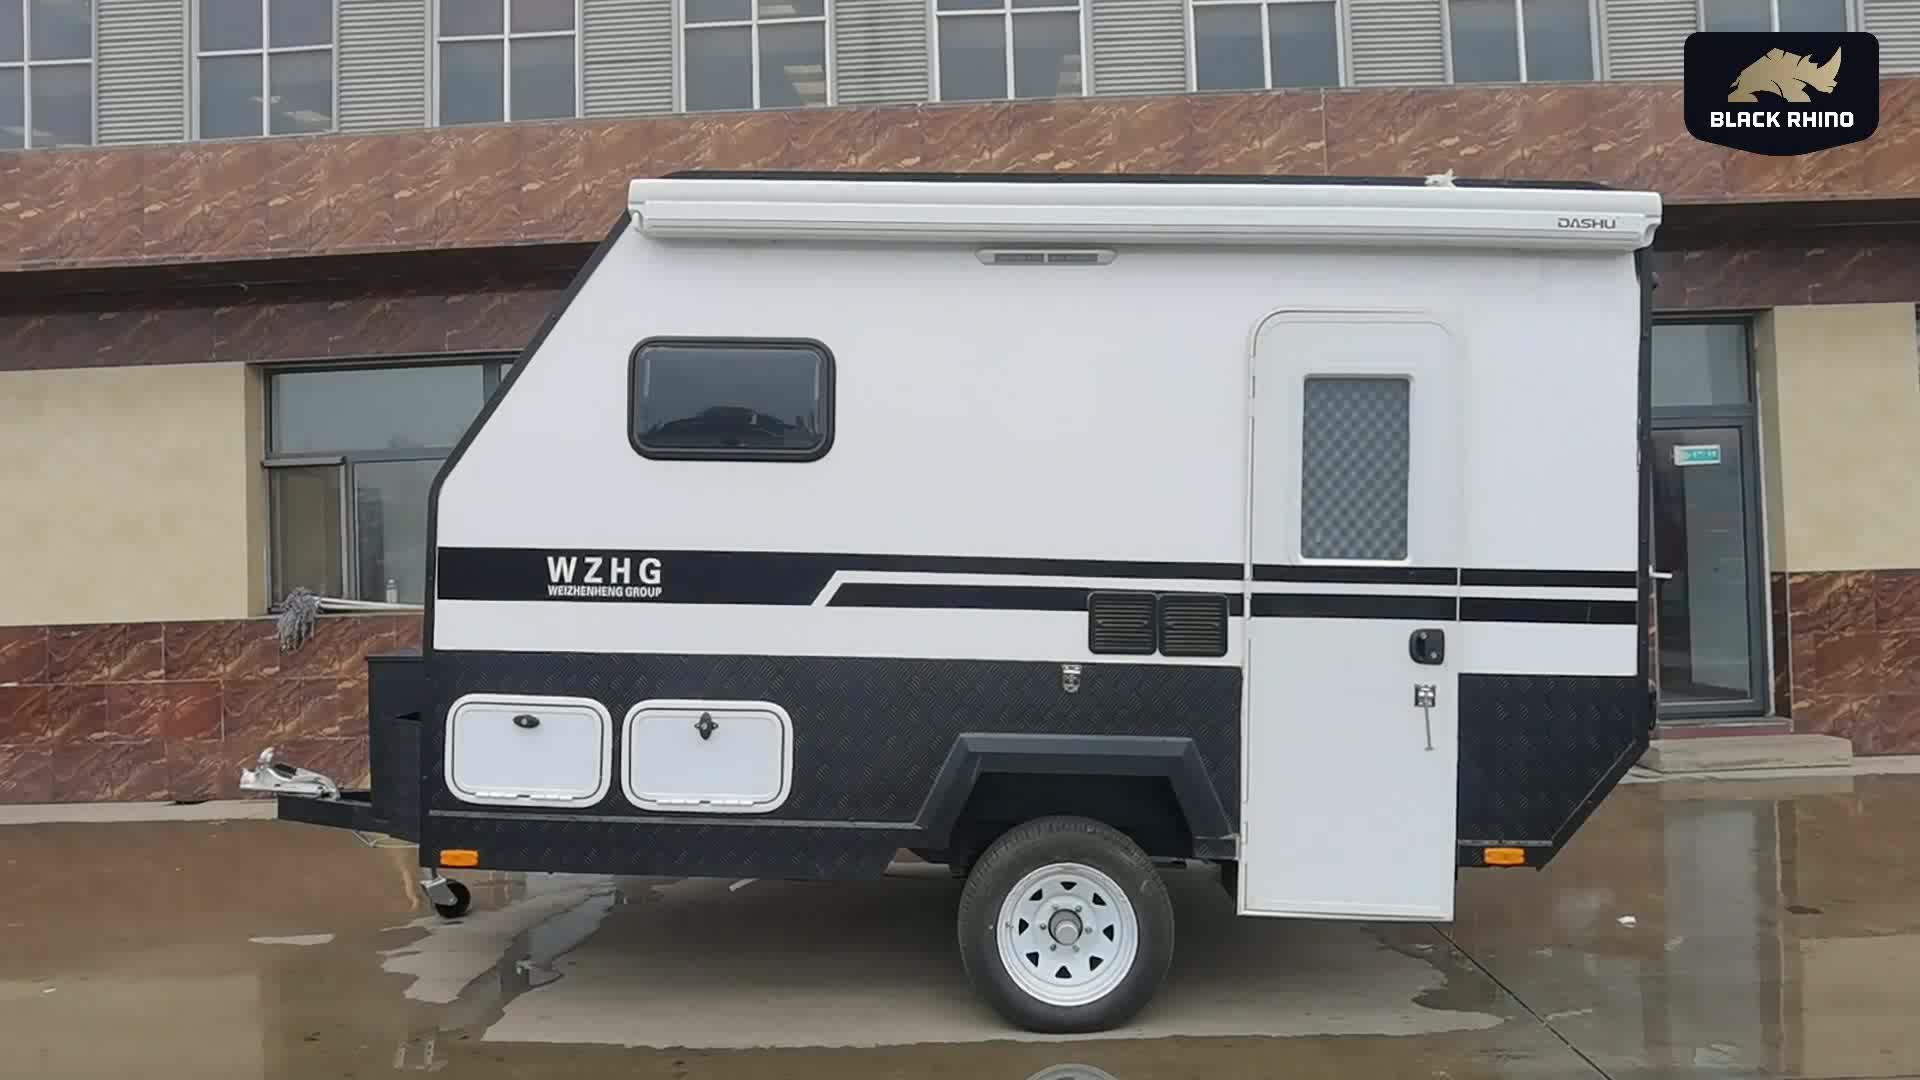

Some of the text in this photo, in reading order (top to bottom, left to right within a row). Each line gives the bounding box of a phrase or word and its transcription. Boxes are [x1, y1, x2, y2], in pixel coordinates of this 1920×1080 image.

[1557, 217, 1617, 230] DASHU
[547, 556, 662, 585] WZHG
[547, 585, 663, 598] WEIZHENHENG GROUP
